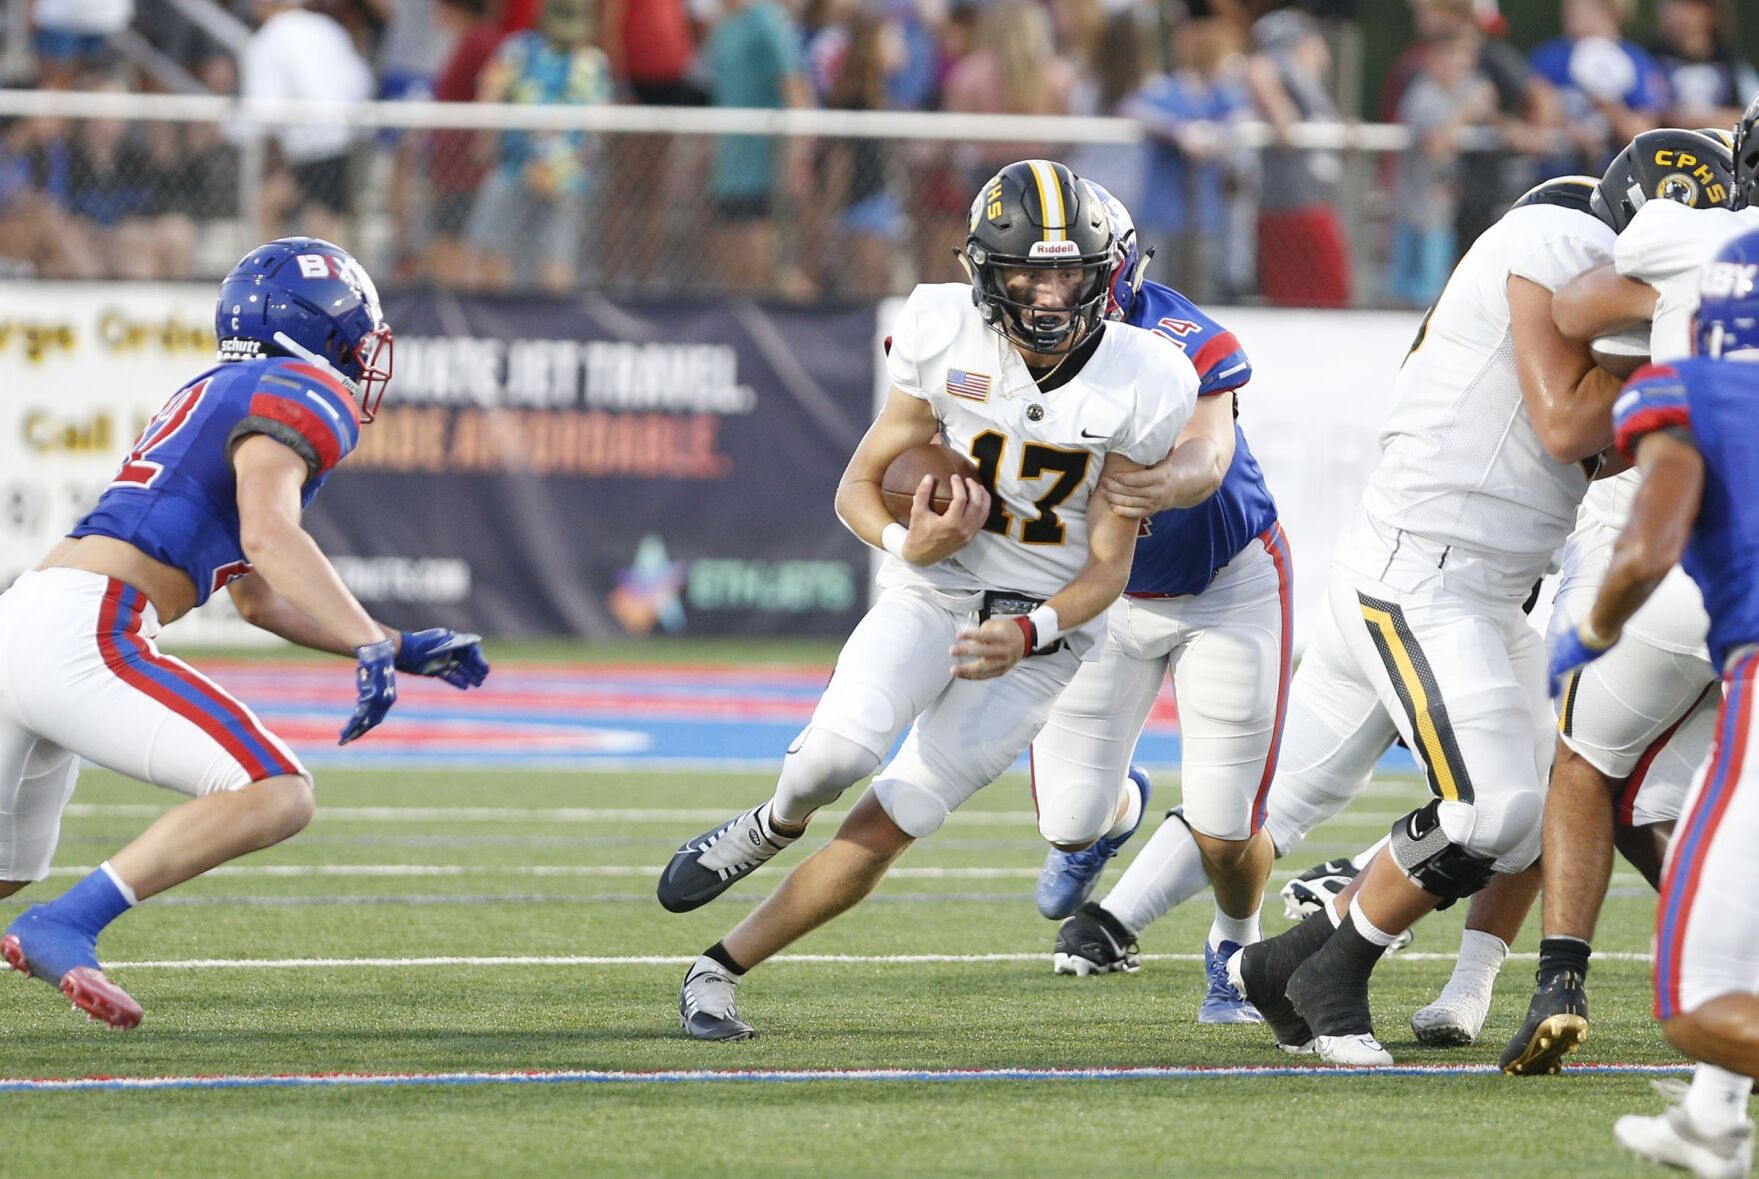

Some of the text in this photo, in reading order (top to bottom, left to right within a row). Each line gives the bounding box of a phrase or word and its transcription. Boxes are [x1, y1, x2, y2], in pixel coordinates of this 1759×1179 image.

[1655, 150, 1727, 203] CPHS
[1037, 244, 1074, 254] Riddell
[221, 337, 262, 353] schutt
[970, 428, 1092, 545] 17
